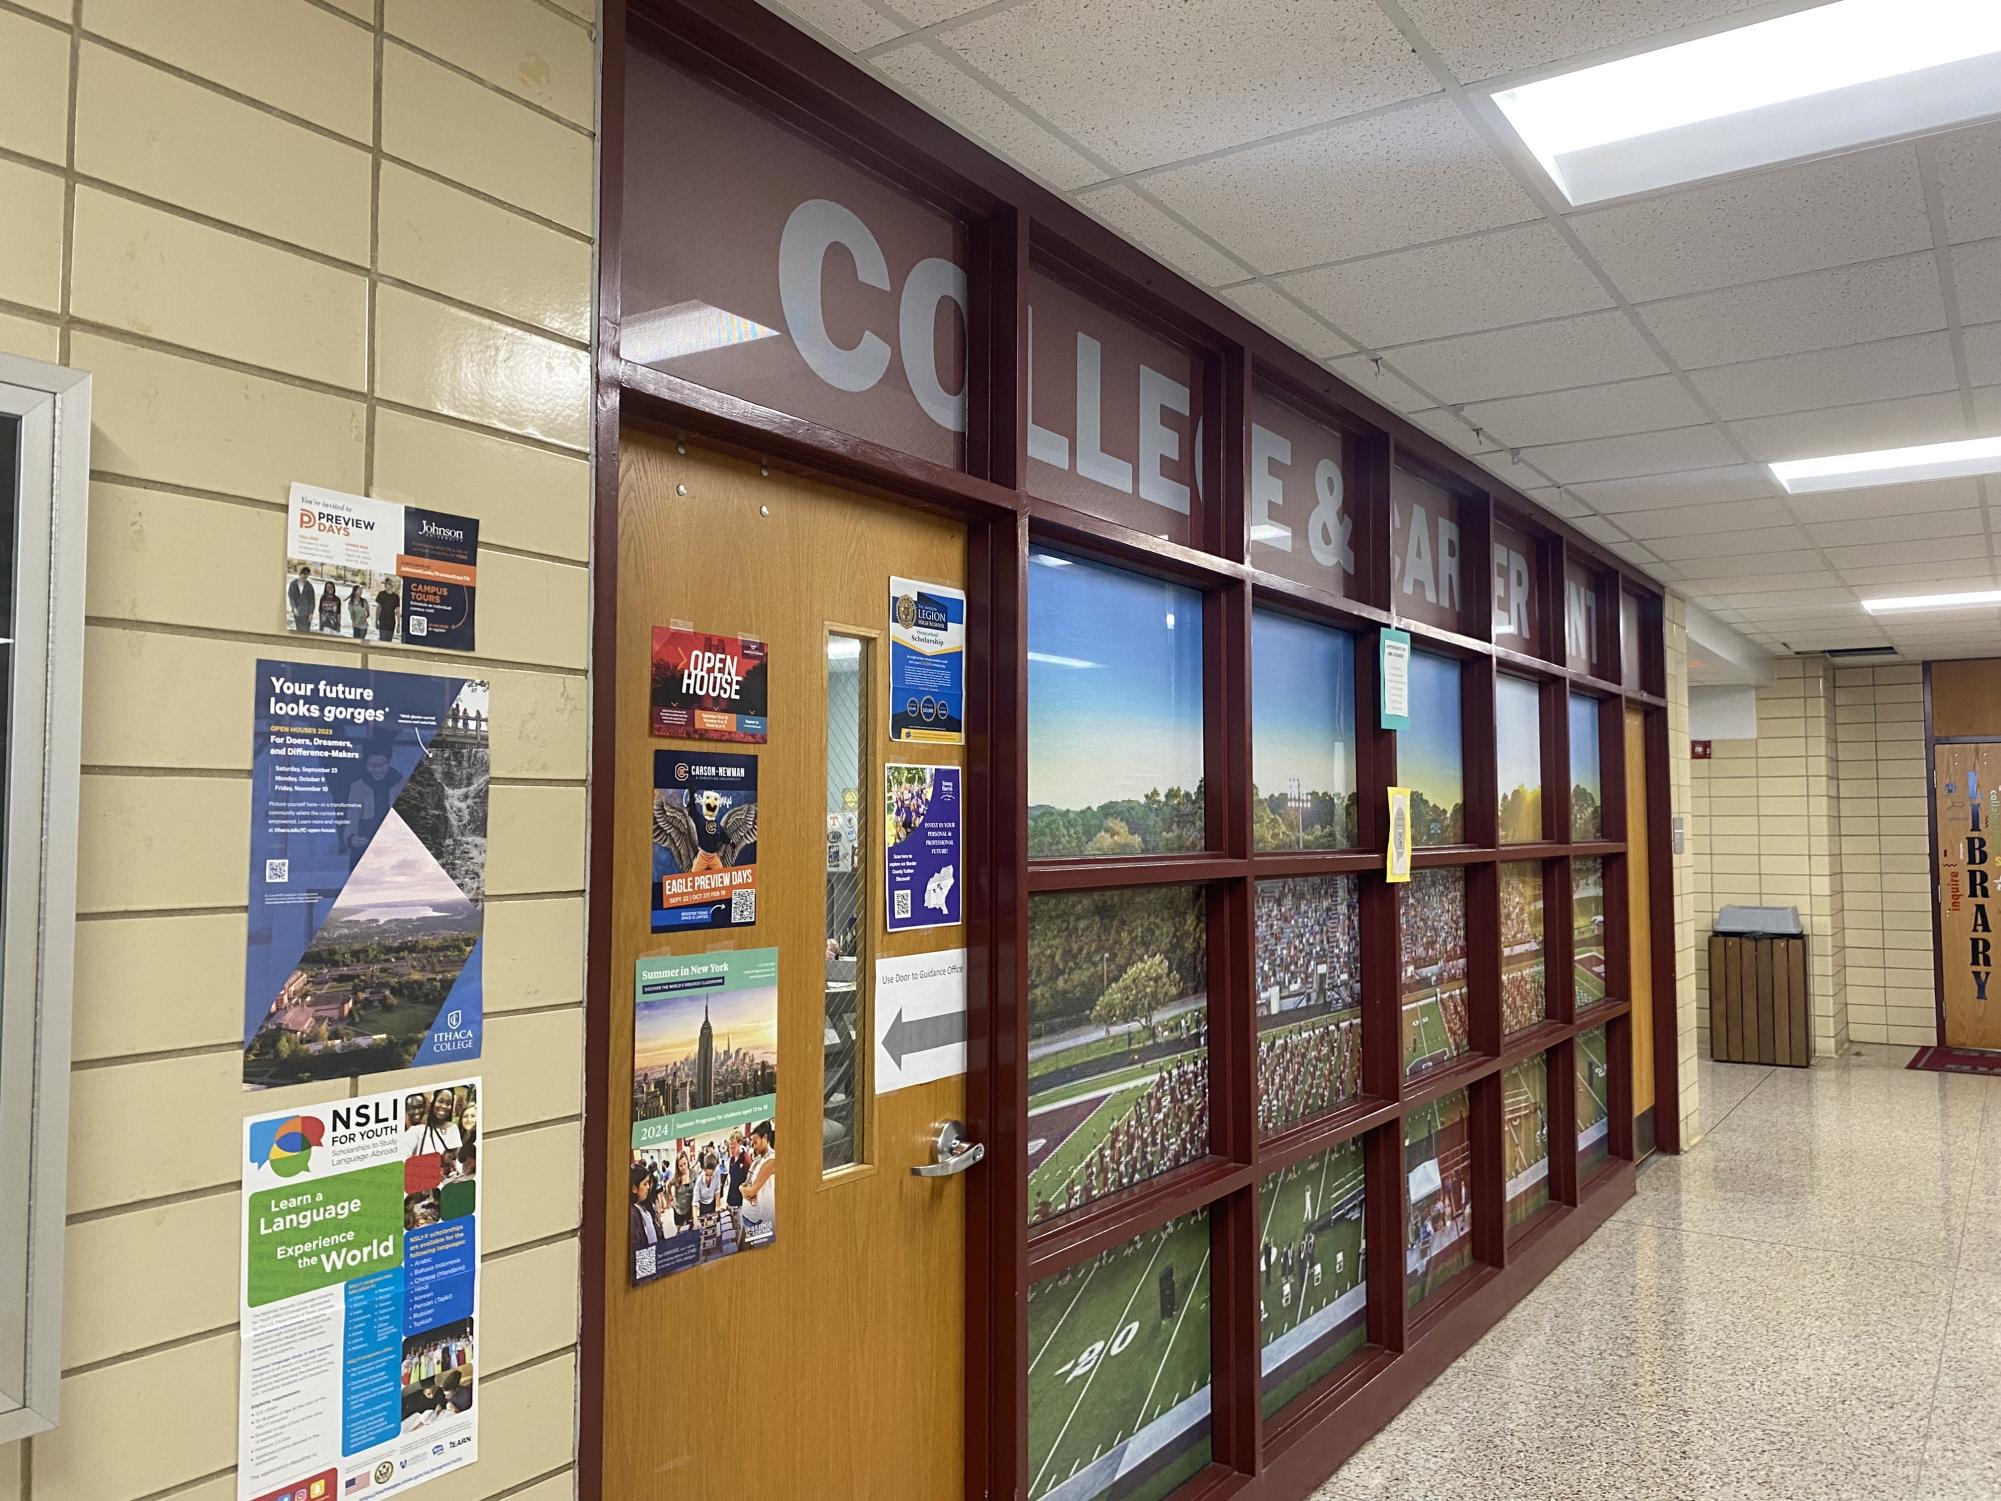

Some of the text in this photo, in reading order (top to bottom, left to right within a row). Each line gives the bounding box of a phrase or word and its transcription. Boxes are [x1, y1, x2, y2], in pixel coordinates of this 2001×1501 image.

[779, 199, 1292, 553] COLLEE
[1308, 459, 1354, 575] &
[301, 497, 321, 506] You're
[322, 501, 345, 511] invited
[318, 512, 375, 531] PREVIEW
[318, 523, 350, 537] DAYS
[419, 520, 463, 538] Johnson
[410, 583, 448, 596] CAMPUS
[410, 592, 441, 603] TOURS
[918, 609, 946, 622] LEGION
[911, 635, 944, 646] Scholarship
[690, 650, 737, 678] OPEN
[271, 676, 374, 701] Your future
[682, 669, 742, 699] HOUSE
[269, 697, 320, 717] looks
[270, 725, 289, 733] OPEN
[270, 736, 284, 744] For
[313, 737, 353, 748] Dreamers,
[270, 748, 360, 759] and Difference-Makers
[275, 765, 301, 773] Saturday,
[301, 766, 331, 774] September
[691, 765, 745, 777] CARSON-NEWMAN
[275, 775, 298, 783] Monday,
[666, 869, 752, 895] EAGLE PREVIEW DAYS
[1947, 872, 1963, 911] inquire
[642, 962, 729, 980] Summer in New York
[882, 964, 963, 985] Use Door to Guidance Office
[434, 1030, 473, 1042] ITHACA
[433, 1040, 473, 1053] COLLEGE
[332, 1098, 398, 1132] NSLI
[676, 1120, 695, 1129] Summer
[724, 1111, 741, 1119] students
[332, 1124, 398, 1147] FOR YOUTH
[641, 1123, 669, 1140] 2024
[332, 1144, 371, 1156] Scholarships
[380, 1139, 398, 1147] Study
[332, 1147, 398, 1166] Language Abroad
[271, 1192, 323, 1212] Learn a
[260, 1198, 361, 1235] Language
[277, 1230, 355, 1259] Experience
[298, 1234, 394, 1273] the World
[414, 1273, 436, 1284] Chinese
